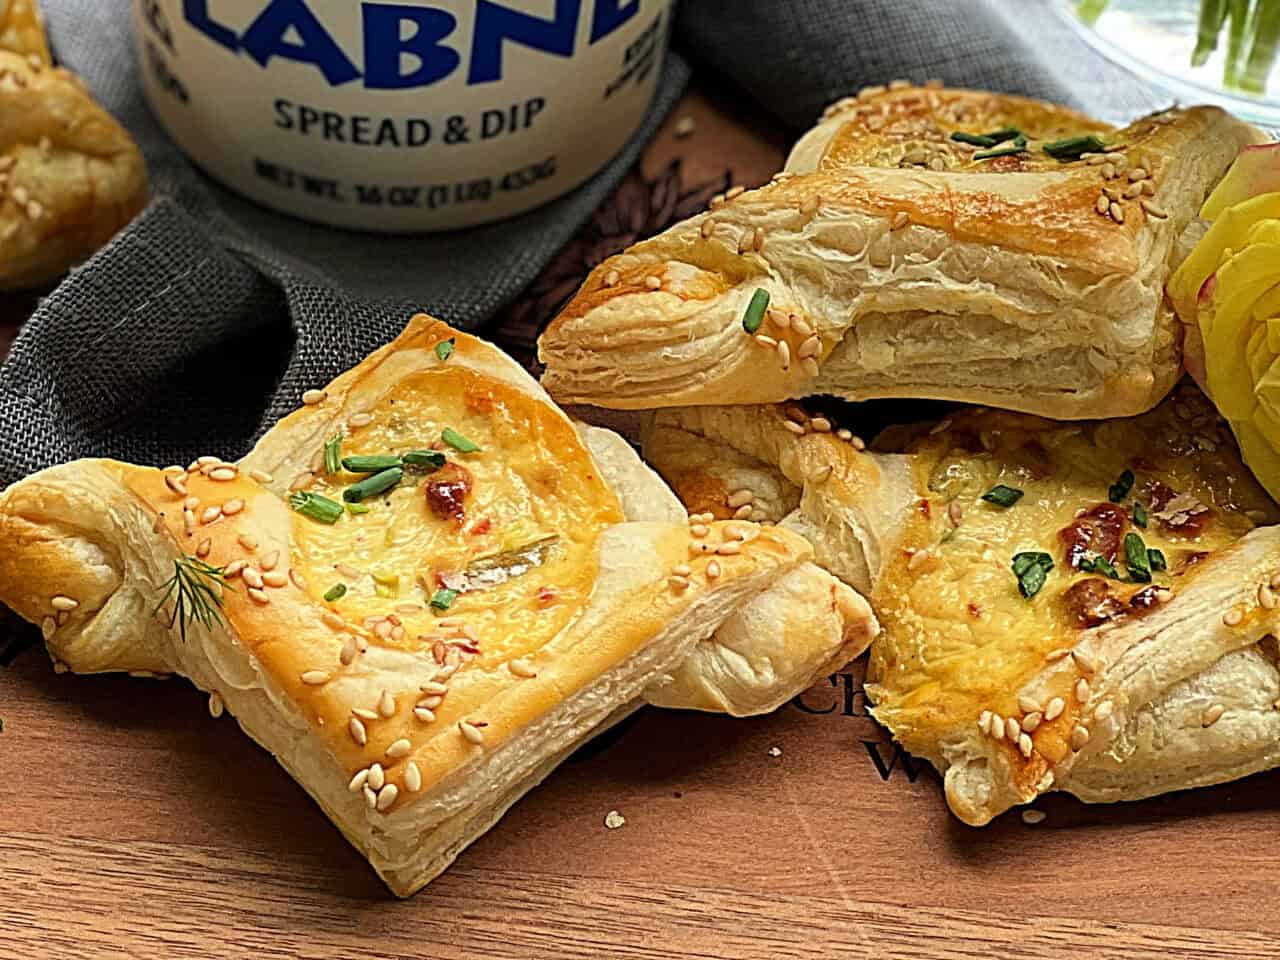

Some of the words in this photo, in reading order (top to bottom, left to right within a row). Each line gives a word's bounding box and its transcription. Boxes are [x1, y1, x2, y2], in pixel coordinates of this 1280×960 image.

[273, 97, 432, 148] SPREAD
[442, 114, 469, 145] &
[479, 95, 546, 140] DIP
